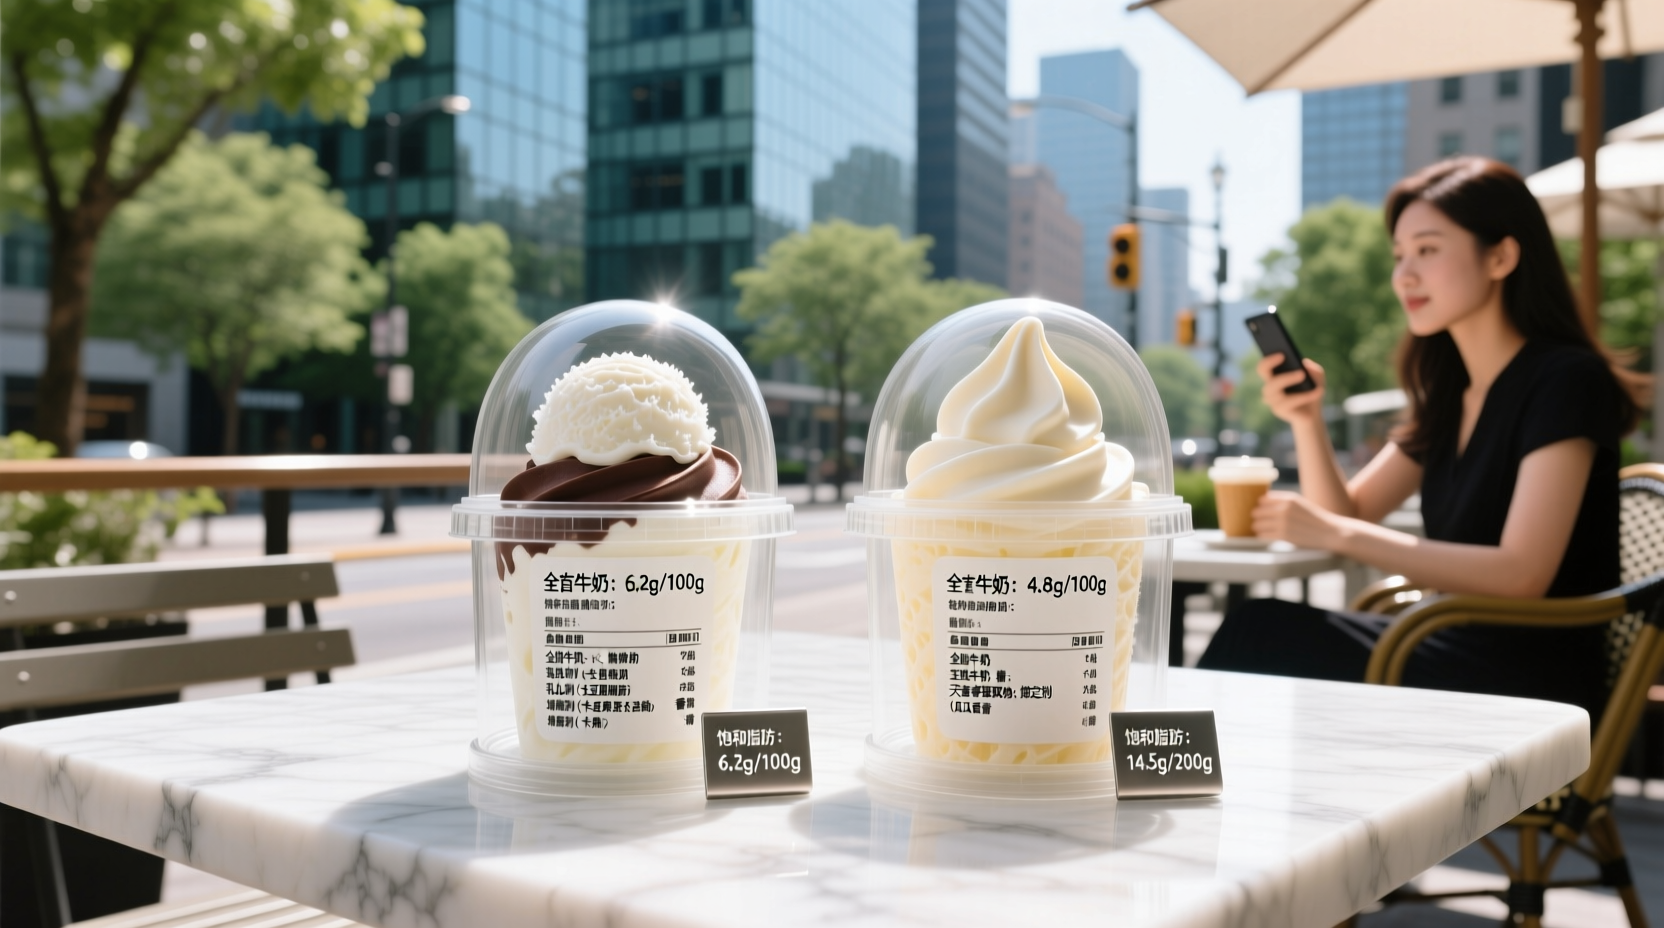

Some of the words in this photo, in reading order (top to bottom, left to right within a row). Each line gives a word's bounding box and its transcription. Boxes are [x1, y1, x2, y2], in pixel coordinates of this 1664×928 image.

[625, 572, 705, 597] 6.2g/100g
[1027, 574, 1107, 598] 4.8g/100g
[718, 752, 801, 776] 6.2g/100g
[1126, 752, 1213, 775] 14.5g/200g
